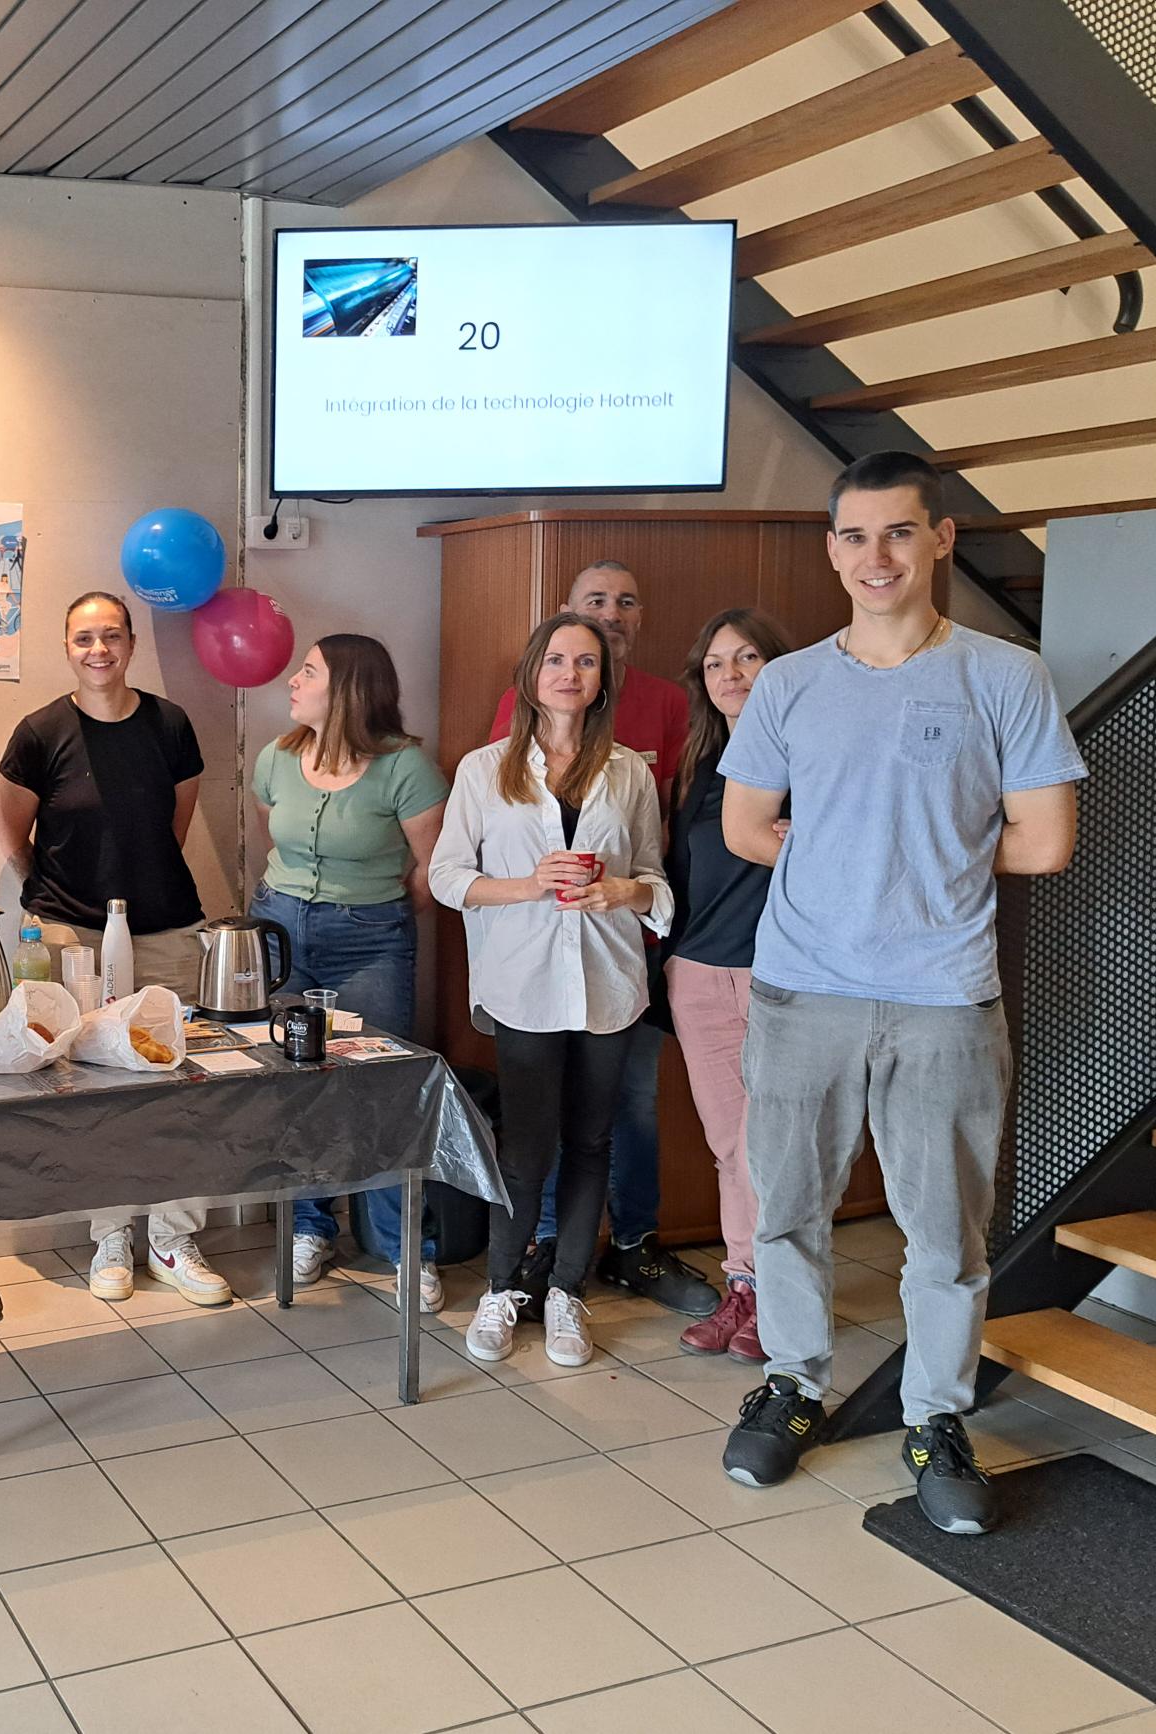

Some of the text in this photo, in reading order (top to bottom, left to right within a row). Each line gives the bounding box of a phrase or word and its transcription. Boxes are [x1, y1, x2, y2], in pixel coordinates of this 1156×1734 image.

[458, 321, 501, 351] 20
[325, 391, 675, 416] Intégration de la technologie Hotmelt
[106, 963, 114, 995] ADESIA
